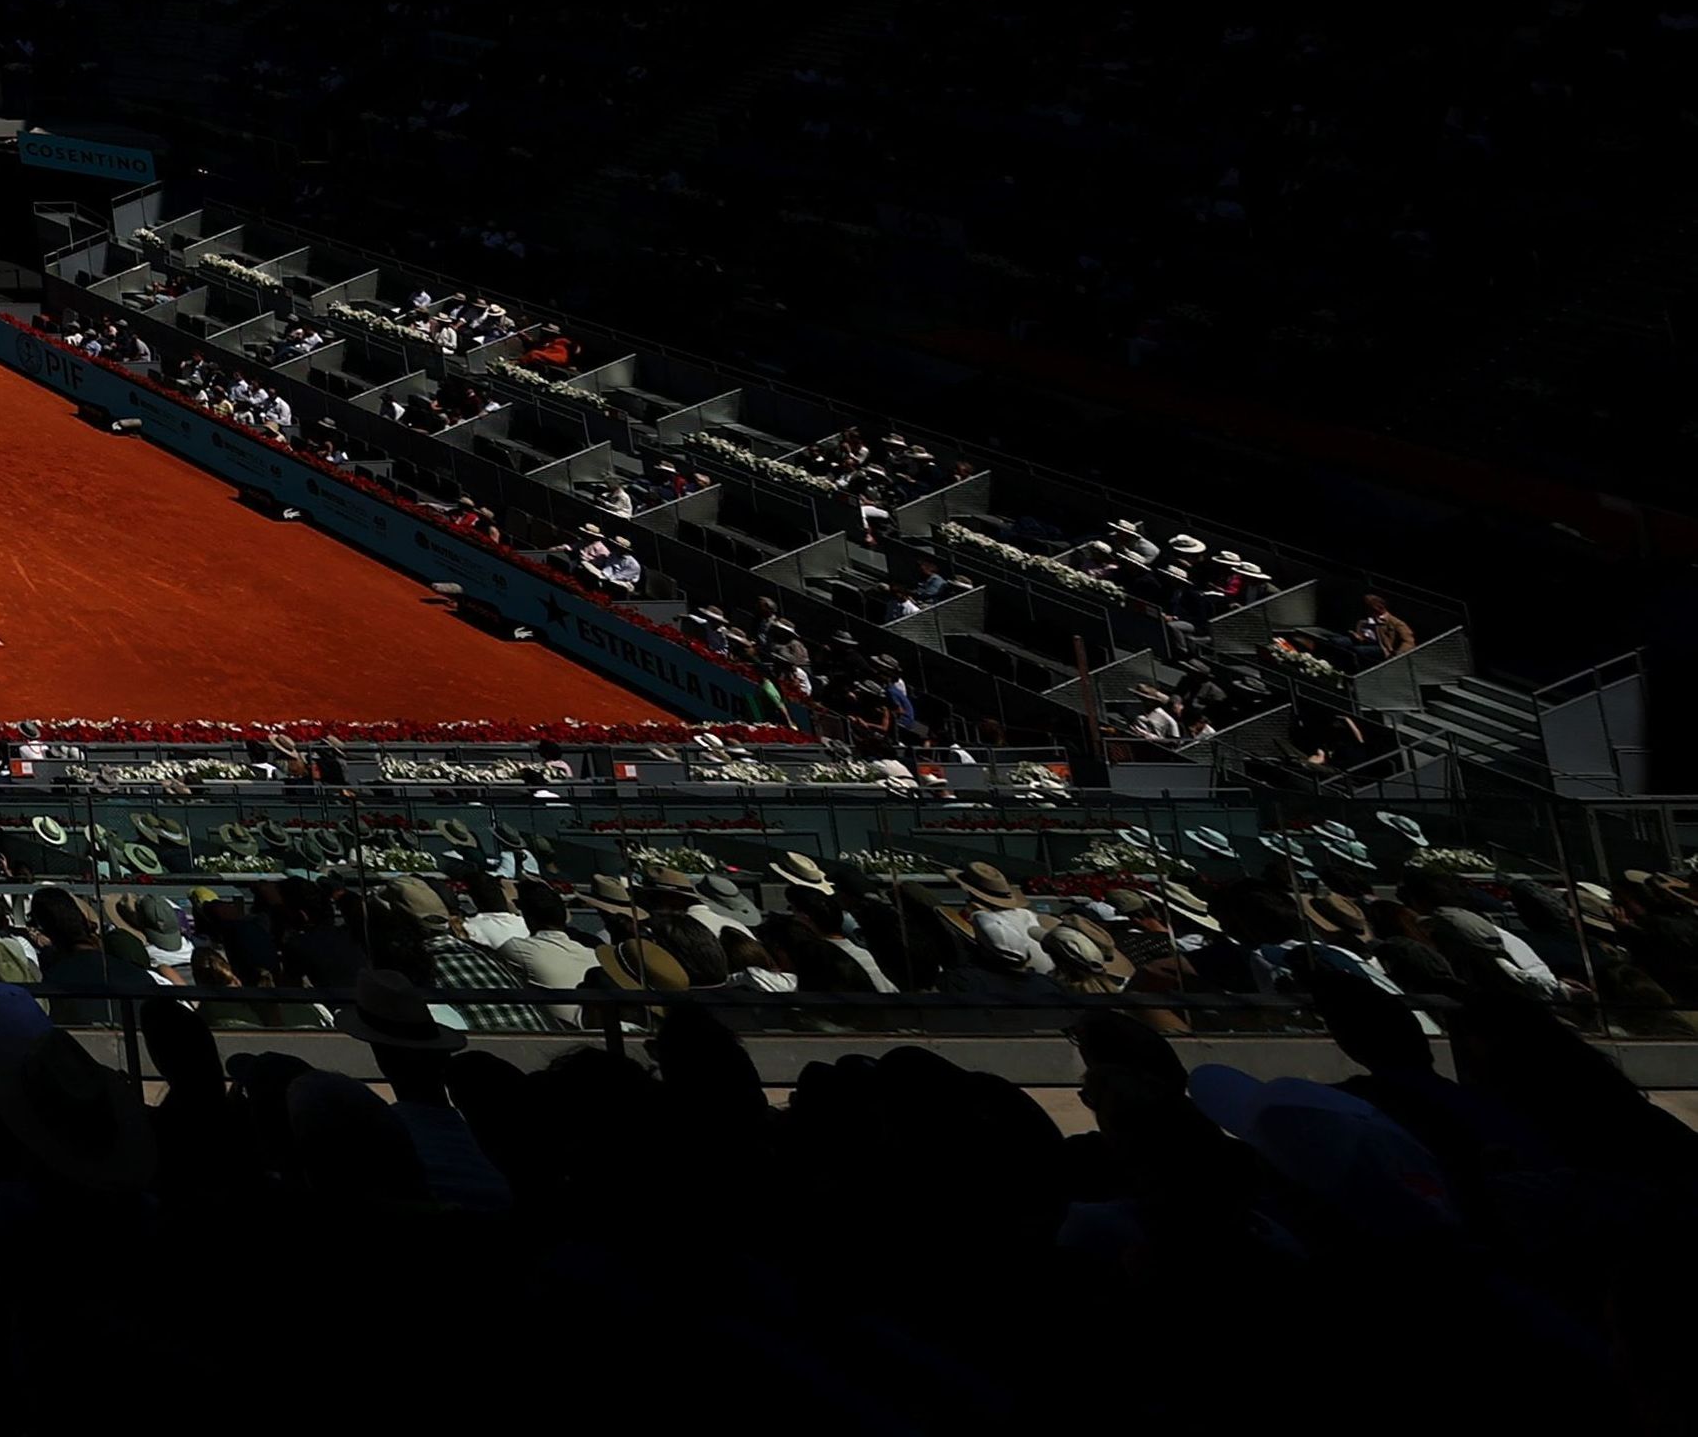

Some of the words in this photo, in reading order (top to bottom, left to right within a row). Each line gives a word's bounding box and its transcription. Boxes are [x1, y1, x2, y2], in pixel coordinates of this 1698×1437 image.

[26, 142, 147, 173] COSENTINO
[45, 349, 84, 390] PIF
[576, 615, 706, 701] ESTRELLA
